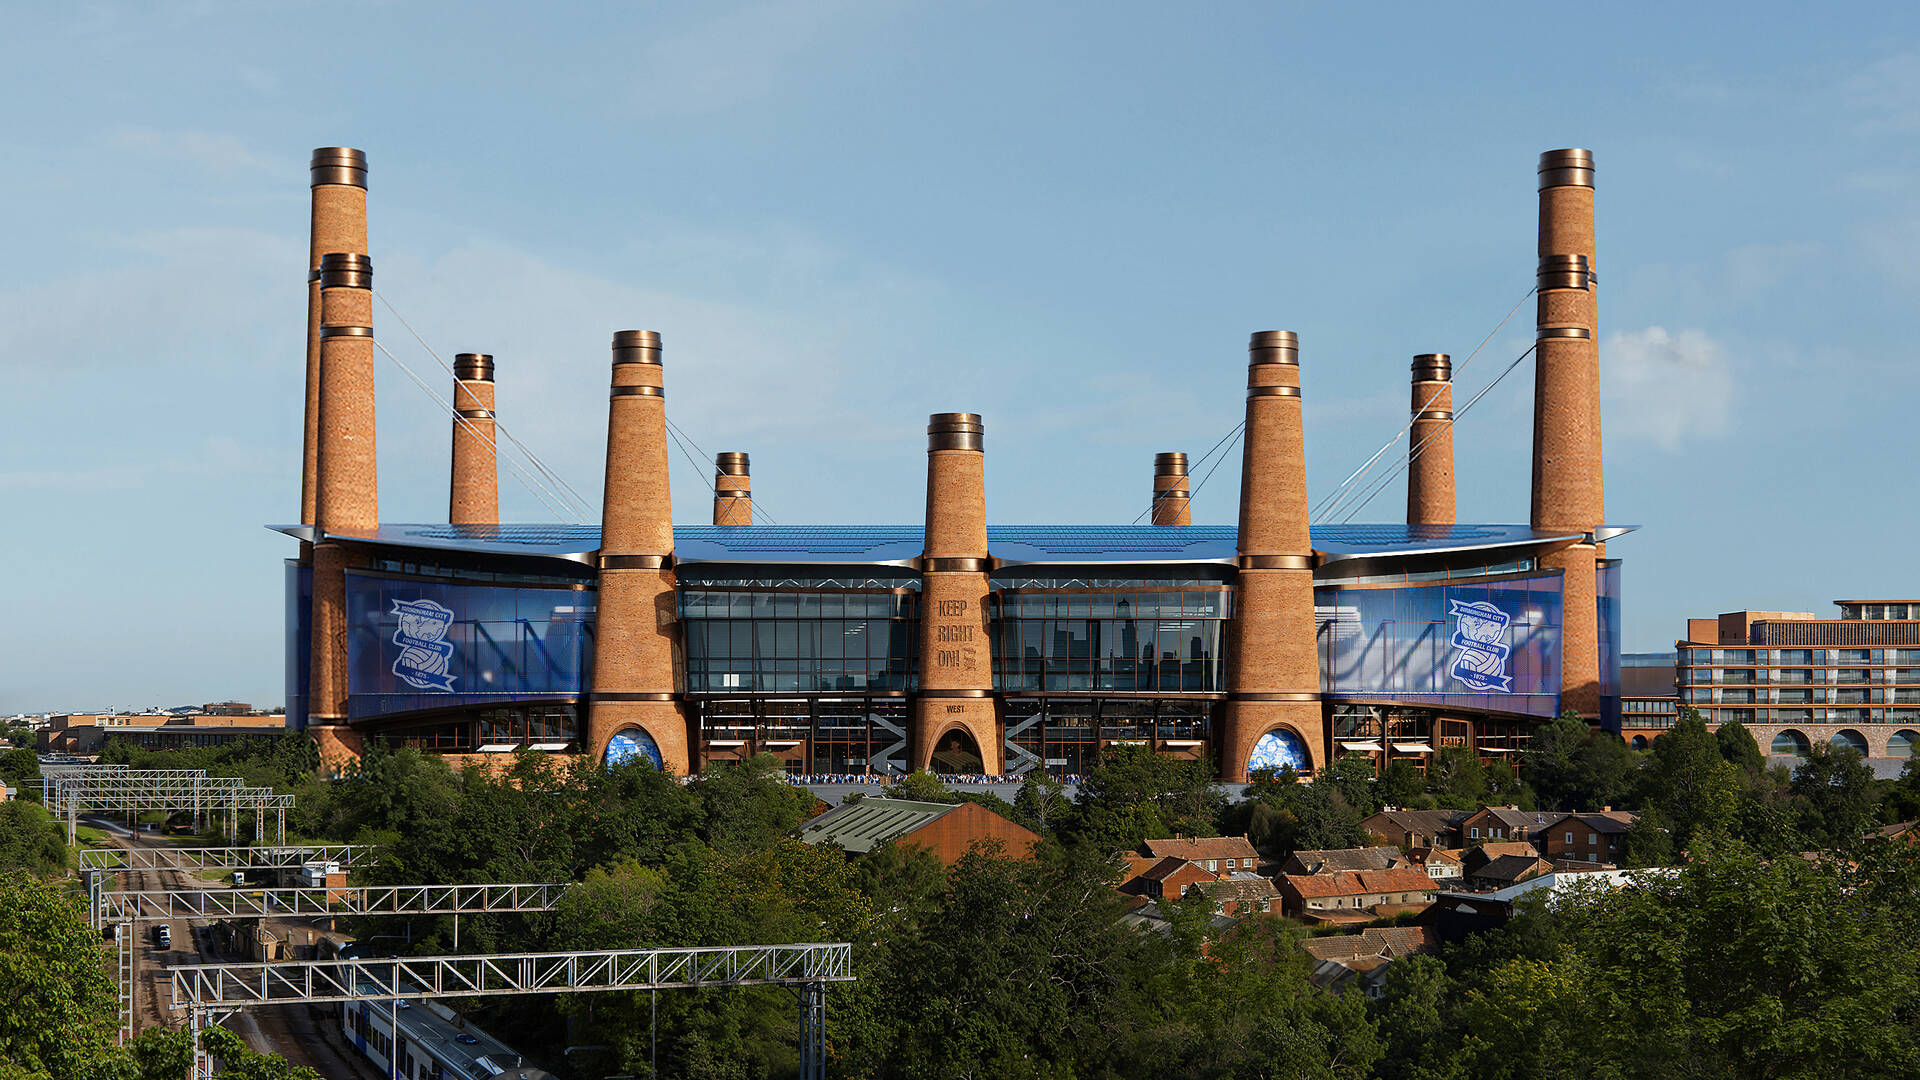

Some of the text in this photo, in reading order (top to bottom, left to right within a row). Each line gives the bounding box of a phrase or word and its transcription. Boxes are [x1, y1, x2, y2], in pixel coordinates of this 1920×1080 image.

[434, 612, 448, 620] CITY
[939, 600, 967, 617] KEEP
[1492, 614, 1505, 622] CITY
[938, 624, 974, 642] RIGHT
[402, 637, 442, 652] FOOTBALL CLUB
[1461, 639, 1499, 654] FOOTBALL CLUB
[938, 649, 960, 667] ON!
[946, 705, 965, 713] WEST
